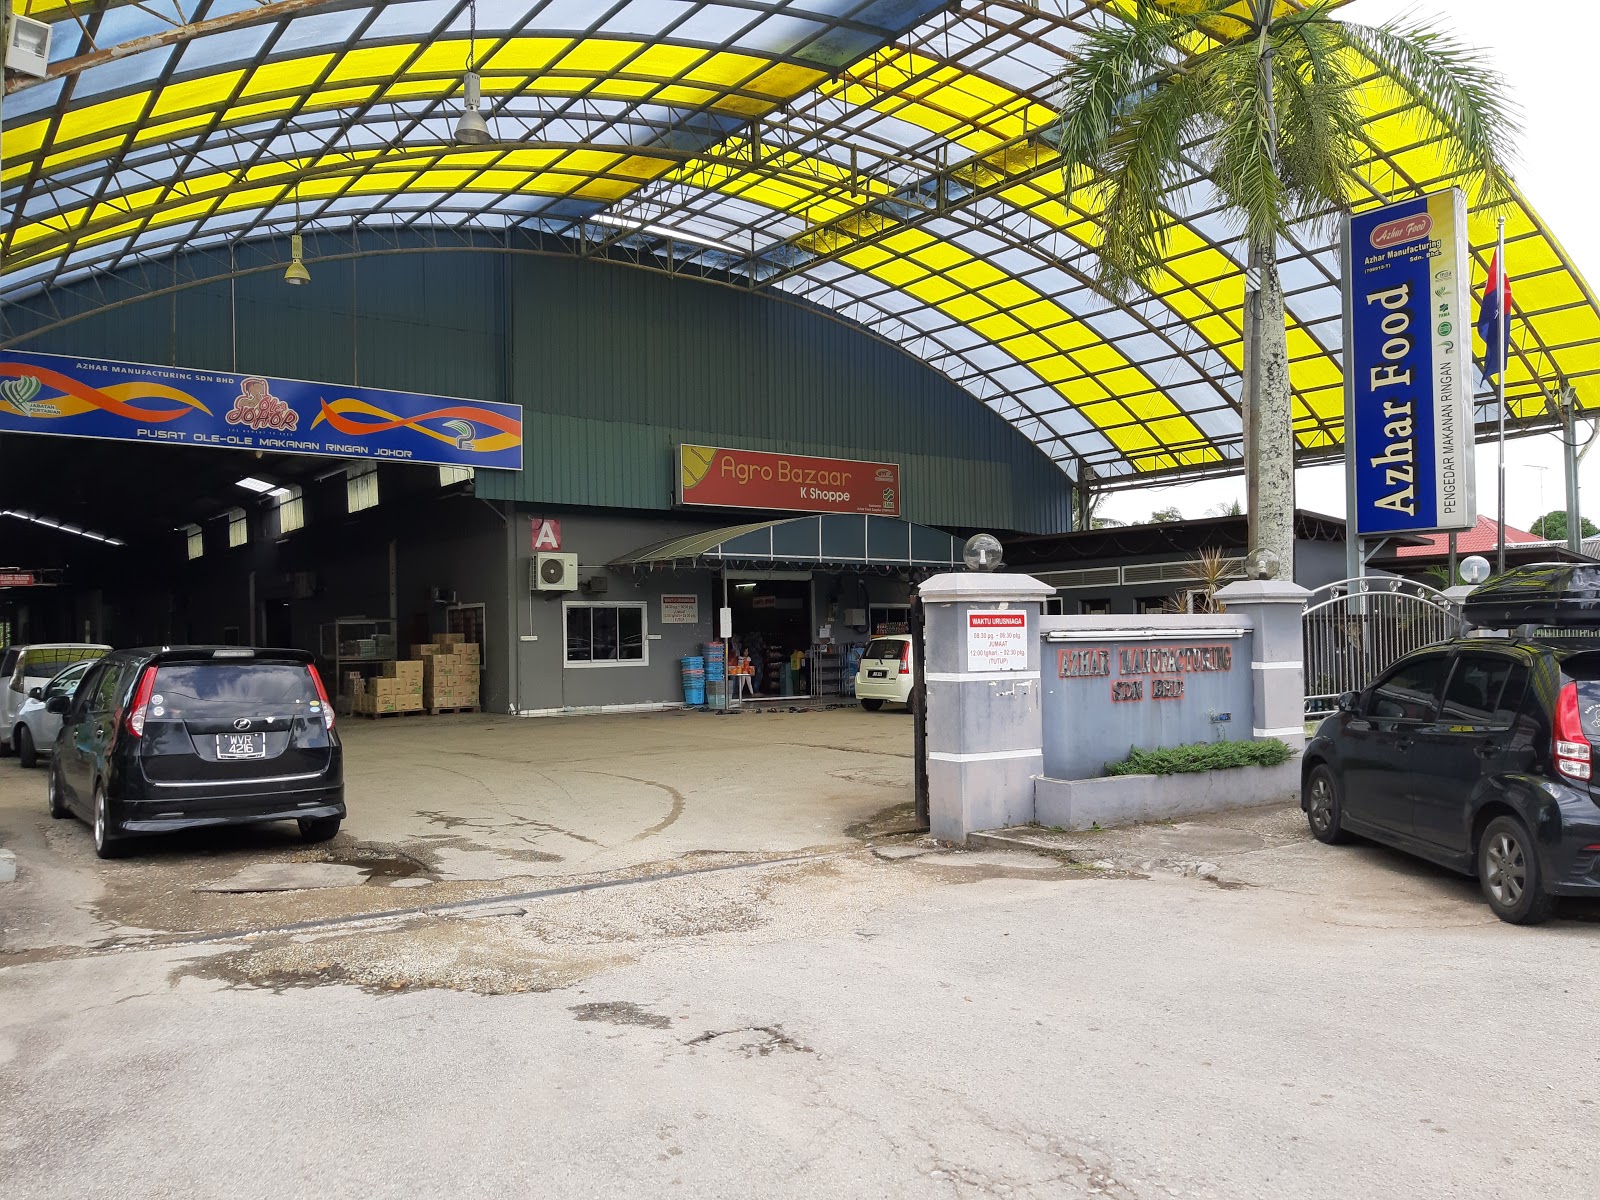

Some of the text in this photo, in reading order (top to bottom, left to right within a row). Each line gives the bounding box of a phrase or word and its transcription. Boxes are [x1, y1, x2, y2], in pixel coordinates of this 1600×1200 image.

[1376, 220, 1426, 242] Azhar Food
[1365, 239, 1441, 265] Azhar Manufacturing
[76, 362, 108, 372] AZHAR
[112, 366, 191, 380] MANUFACTURING
[1366, 283, 1414, 516] Azhar Food
[227, 406, 297, 429] JOHOR
[137, 428, 413, 458] PUSAT OLE-OLE MAKANAN RINGAN JOHOR
[1440, 362, 1456, 514] PENGEDAR MAKANAN RINGAN
[721, 455, 852, 487] Agro Bazaar
[800, 486, 850, 503] K Shoppe
[535, 522, 558, 548] A
[972, 617, 1022, 625] WAKTU URUSNIAGA
[1060, 646, 1231, 677] AZHAR MANUFACTURING
[1113, 681, 1143, 701] SDN
[229, 744, 253, 753] 4216
[230, 735, 251, 744] WVR
